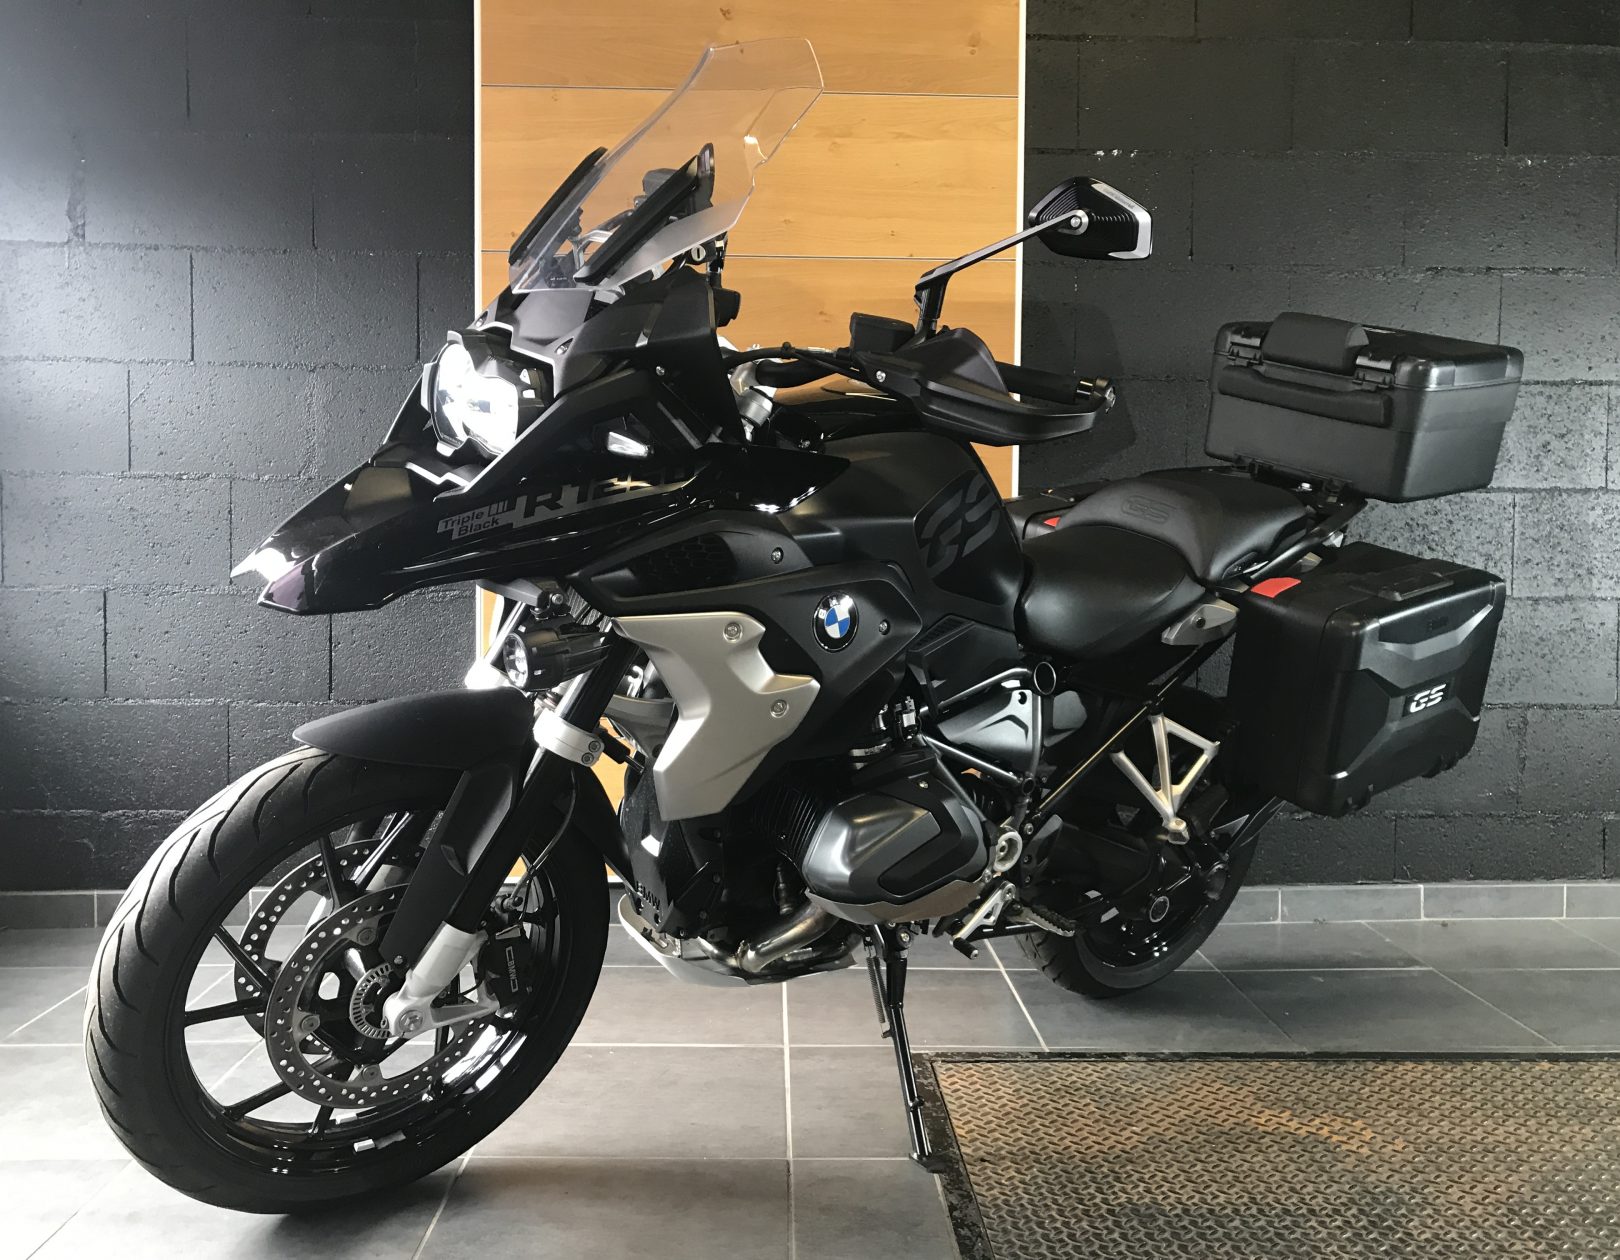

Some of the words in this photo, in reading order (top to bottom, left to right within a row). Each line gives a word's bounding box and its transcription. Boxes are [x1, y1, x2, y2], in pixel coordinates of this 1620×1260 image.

[442, 511, 484, 529] Triple
[458, 517, 500, 537] Black
[920, 472, 1000, 579] GS
[1409, 683, 1447, 713] GS
